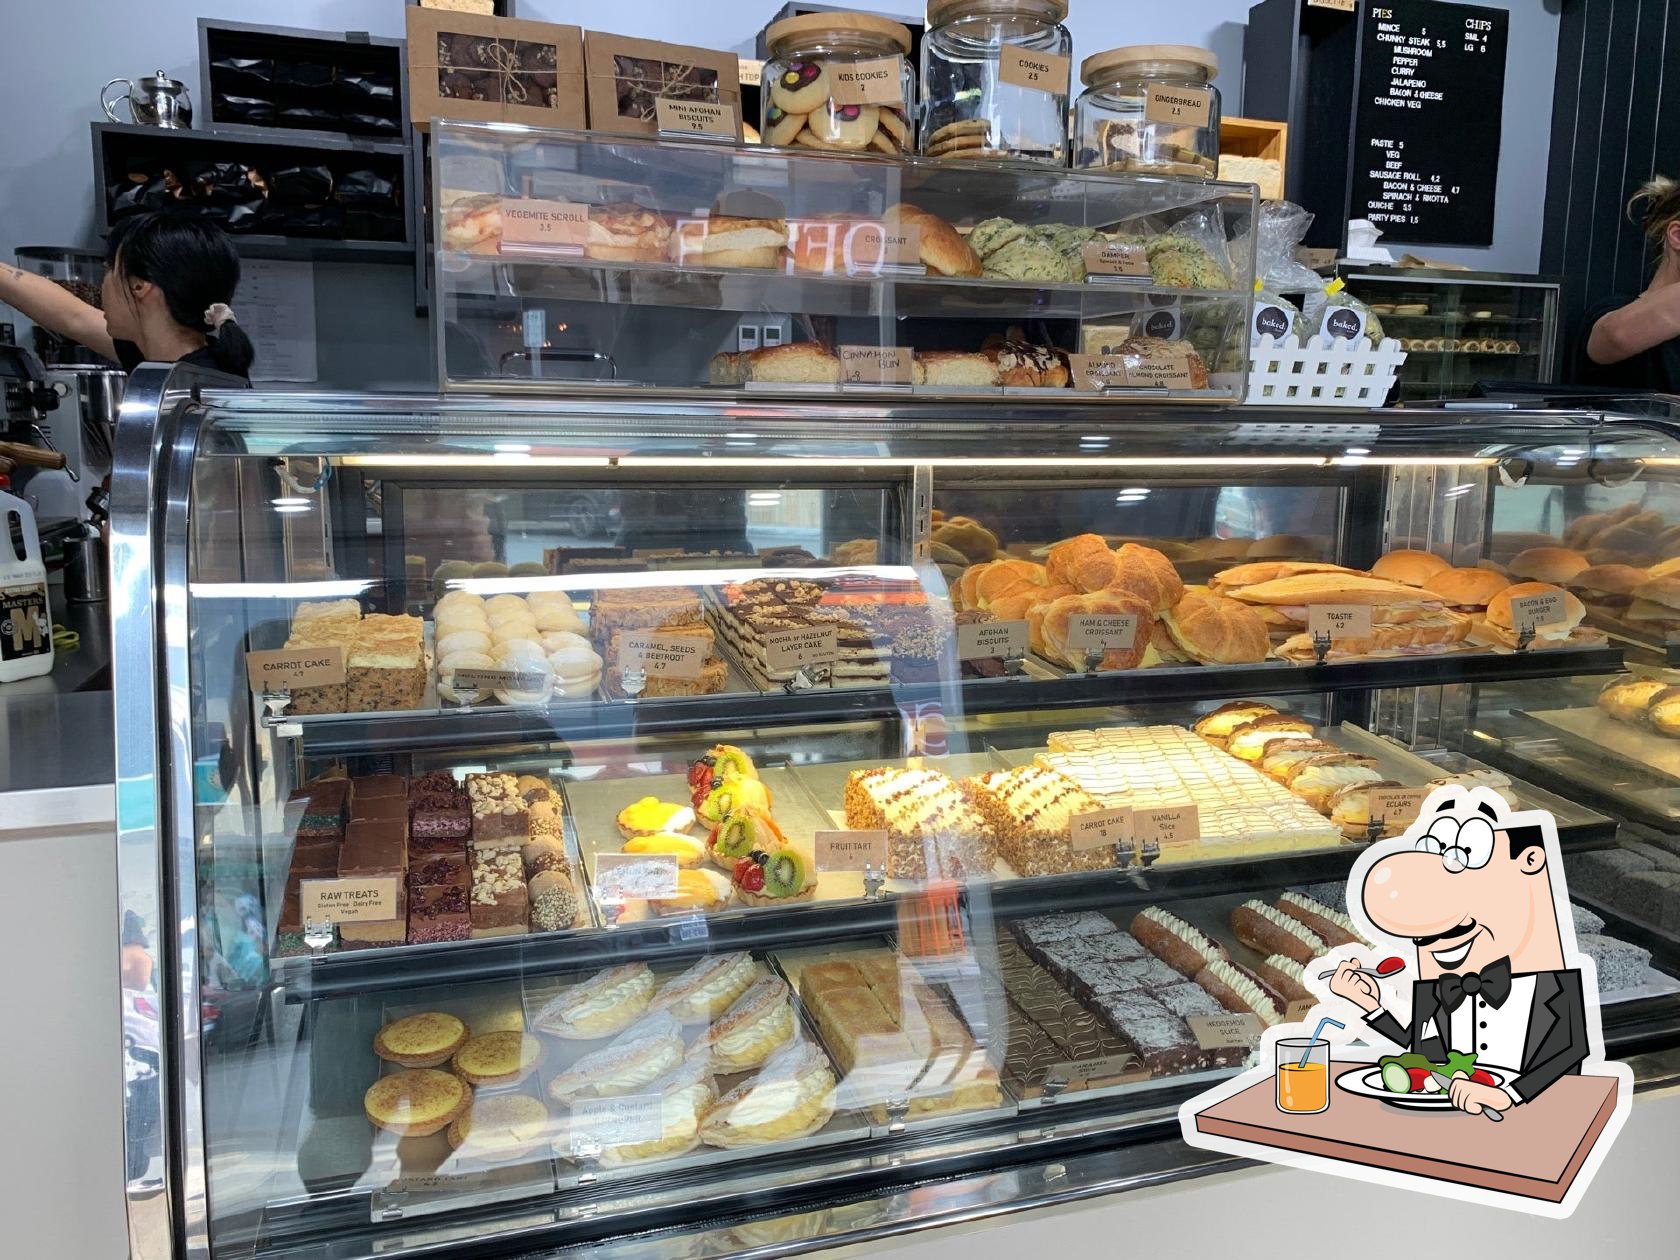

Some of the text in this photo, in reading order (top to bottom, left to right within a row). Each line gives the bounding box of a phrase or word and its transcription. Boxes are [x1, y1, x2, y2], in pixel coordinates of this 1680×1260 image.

[1372, 8, 1393, 19] PIES
[1378, 22, 1427, 36] MINCE 5
[1465, 18, 1492, 31] CHIPS
[1376, 33, 1406, 44] CHUNKY
[1408, 36, 1430, 47] STEAK
[1464, 32, 1488, 43] SML 4
[1393, 45, 1433, 57] MUSHROOM
[1464, 43, 1486, 53] LG 6
[1018, 59, 1049, 73] COOKIES
[1392, 56, 1418, 66] PEPPER
[838, 70, 889, 82] KIDS COOKIES
[1391, 66, 1415, 76] CURRY
[1390, 77, 1426, 88] JALAPENO
[1389, 87, 1411, 97] BACON
[1419, 91, 1443, 101] CHEESE
[1154, 94, 1202, 108] GINGERBREAD
[1374, 96, 1421, 109] CHICKEN VEG
[668, 103, 721, 116] MINI AFGHAN
[679, 113, 715, 124] BISCUITS
[1371, 138, 1404, 149] PASTIE 5
[1386, 150, 1400, 159] VEG
[1385, 160, 1402, 169] BEEF
[1369, 170, 1402, 180] SAUSAGE
[1403, 172, 1421, 181] ROLL
[1383, 181, 1408, 190] BACON
[1416, 184, 1442, 193] CHEESE
[1383, 191, 1412, 201] SPINACH
[505, 208, 585, 223] VEGEMITE SCROLL
[1368, 213, 1389, 222] PARTY
[1389, 214, 1406, 223] PIES
[878, 359, 900, 369] BUN
[1327, 612, 1353, 620] TOASTIE
[1080, 619, 1095, 627] HAM
[1103, 619, 1129, 627] CHEESE
[769, 636, 792, 645] MOCHA
[800, 630, 833, 641] HAZELNUT
[979, 628, 1009, 636] AFGHAN
[1085, 628, 1123, 636] CROISSANT
[781, 641, 823, 652] LAYER CAKE
[977, 637, 1010, 646] BISCUITS
[669, 645, 696, 654] SEEDS
[645, 652, 685, 662] BEETROOT
[263, 658, 331, 671] CARROT CAKE
[1385, 800, 1412, 808] ECLAIRS
[1151, 812, 1181, 822] VANILLA
[1080, 816, 1125, 830] CARROT CAKE
[1159, 822, 1175, 830] Slice
[830, 842, 873, 850] FRUIT TART
[320, 889, 379, 901] RAW TREATS
